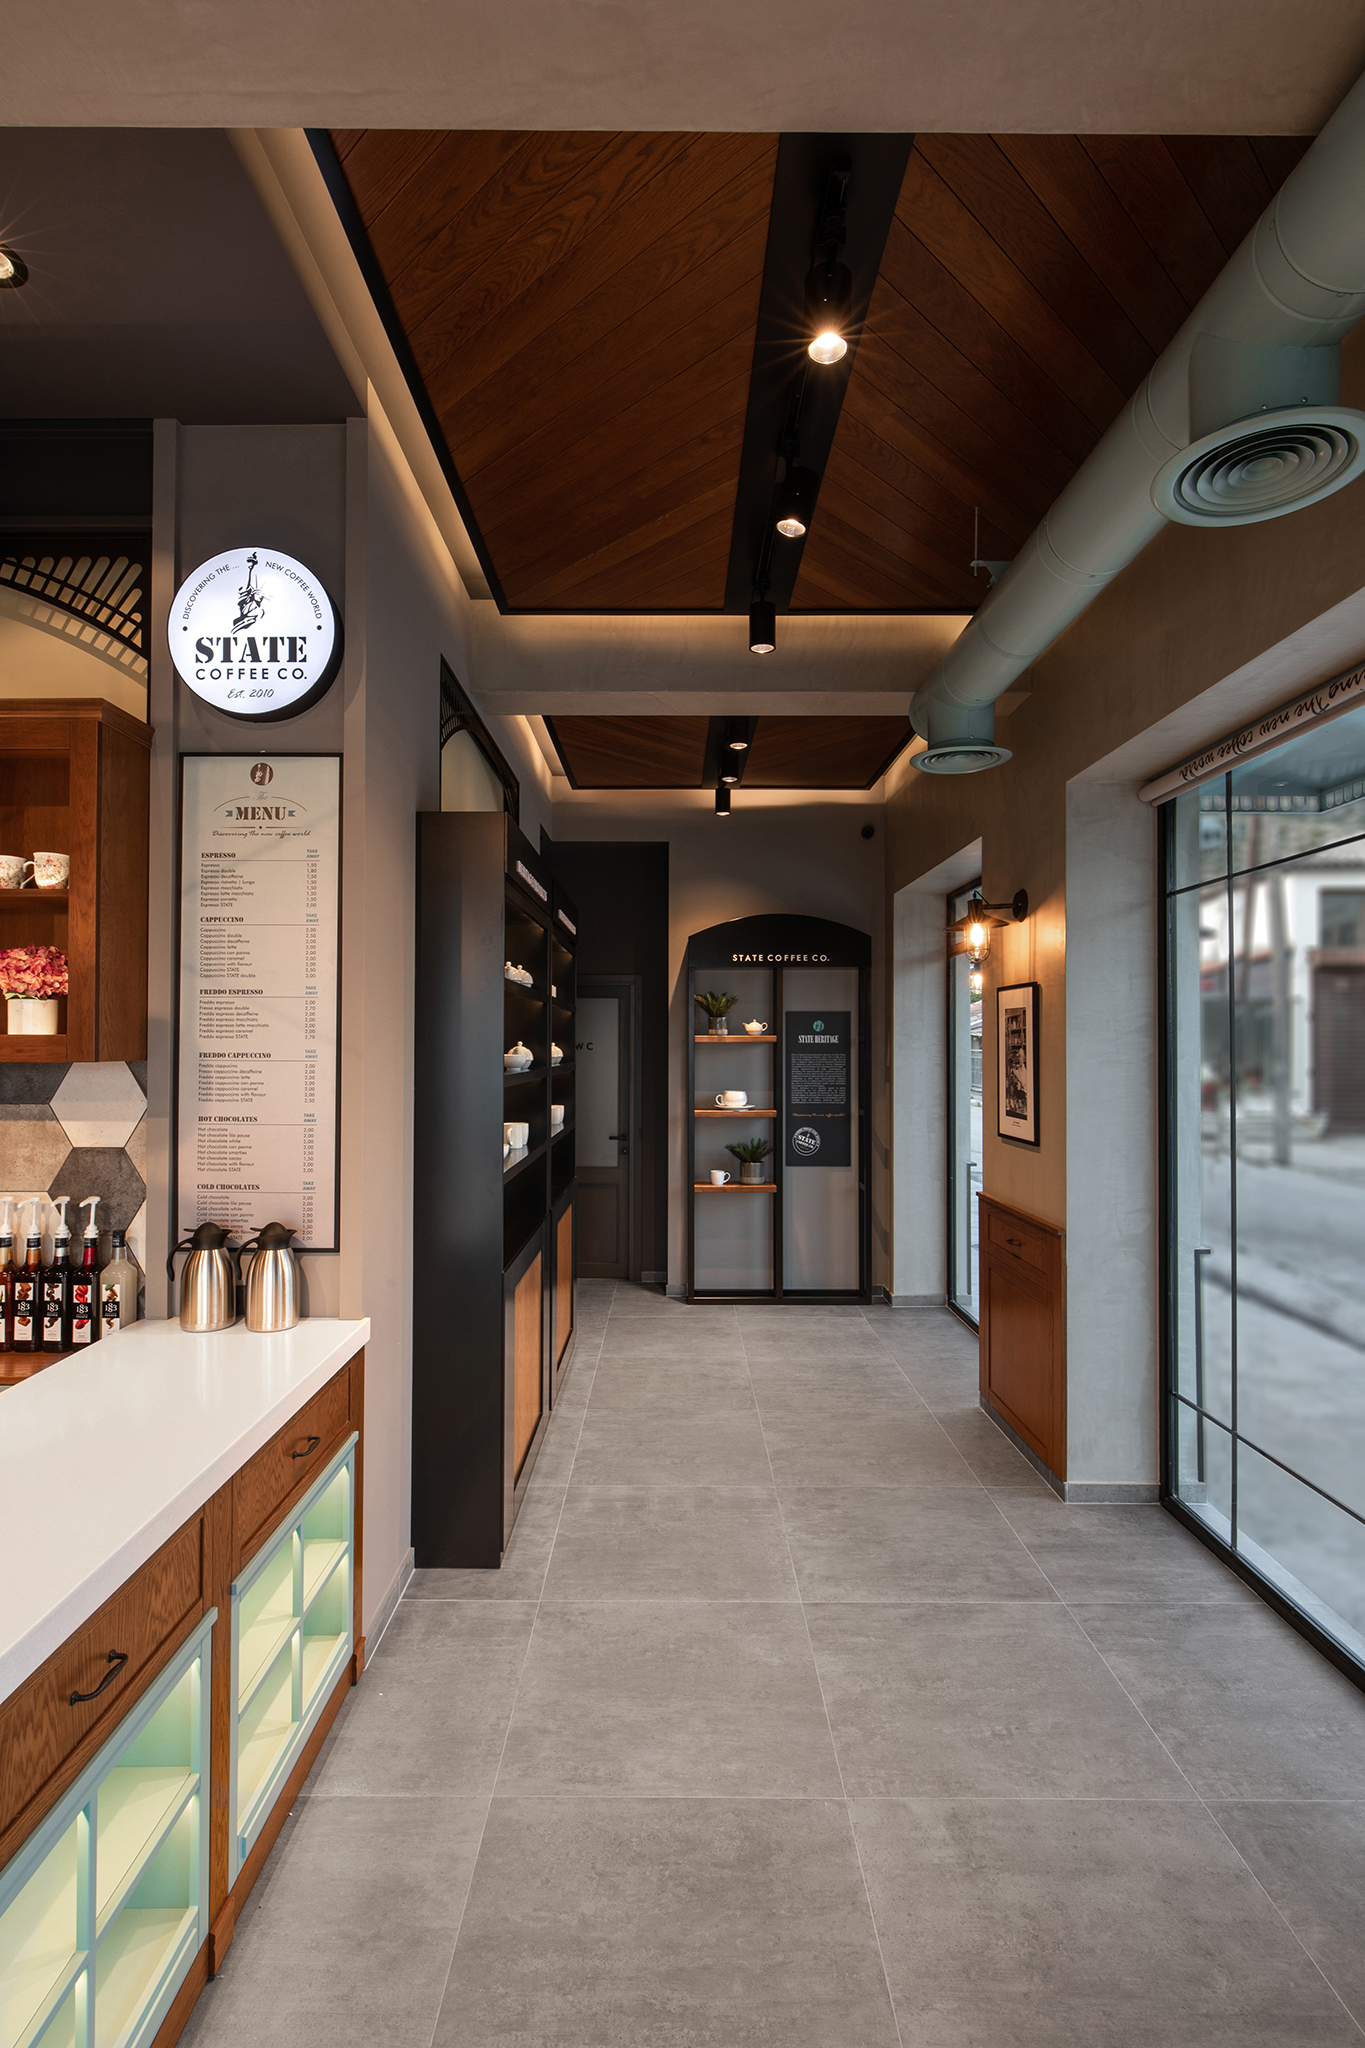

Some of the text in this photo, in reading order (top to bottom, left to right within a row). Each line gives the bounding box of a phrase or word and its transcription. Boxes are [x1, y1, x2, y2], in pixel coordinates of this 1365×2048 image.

[182, 564, 230, 620] DISCOVERING THE
[265, 561, 322, 619] NEW COFFEE WORLD
[195, 636, 307, 664] STATE
[195, 668, 307, 680] COFFEE CO.
[249, 688, 274, 698] 2010
[1259, 712, 1290, 736] new
[235, 806, 286, 820] MENU
[732, 954, 830, 962] STATE COFFEE CO.
[798, 1035, 839, 1043] STATE HERITAGE
